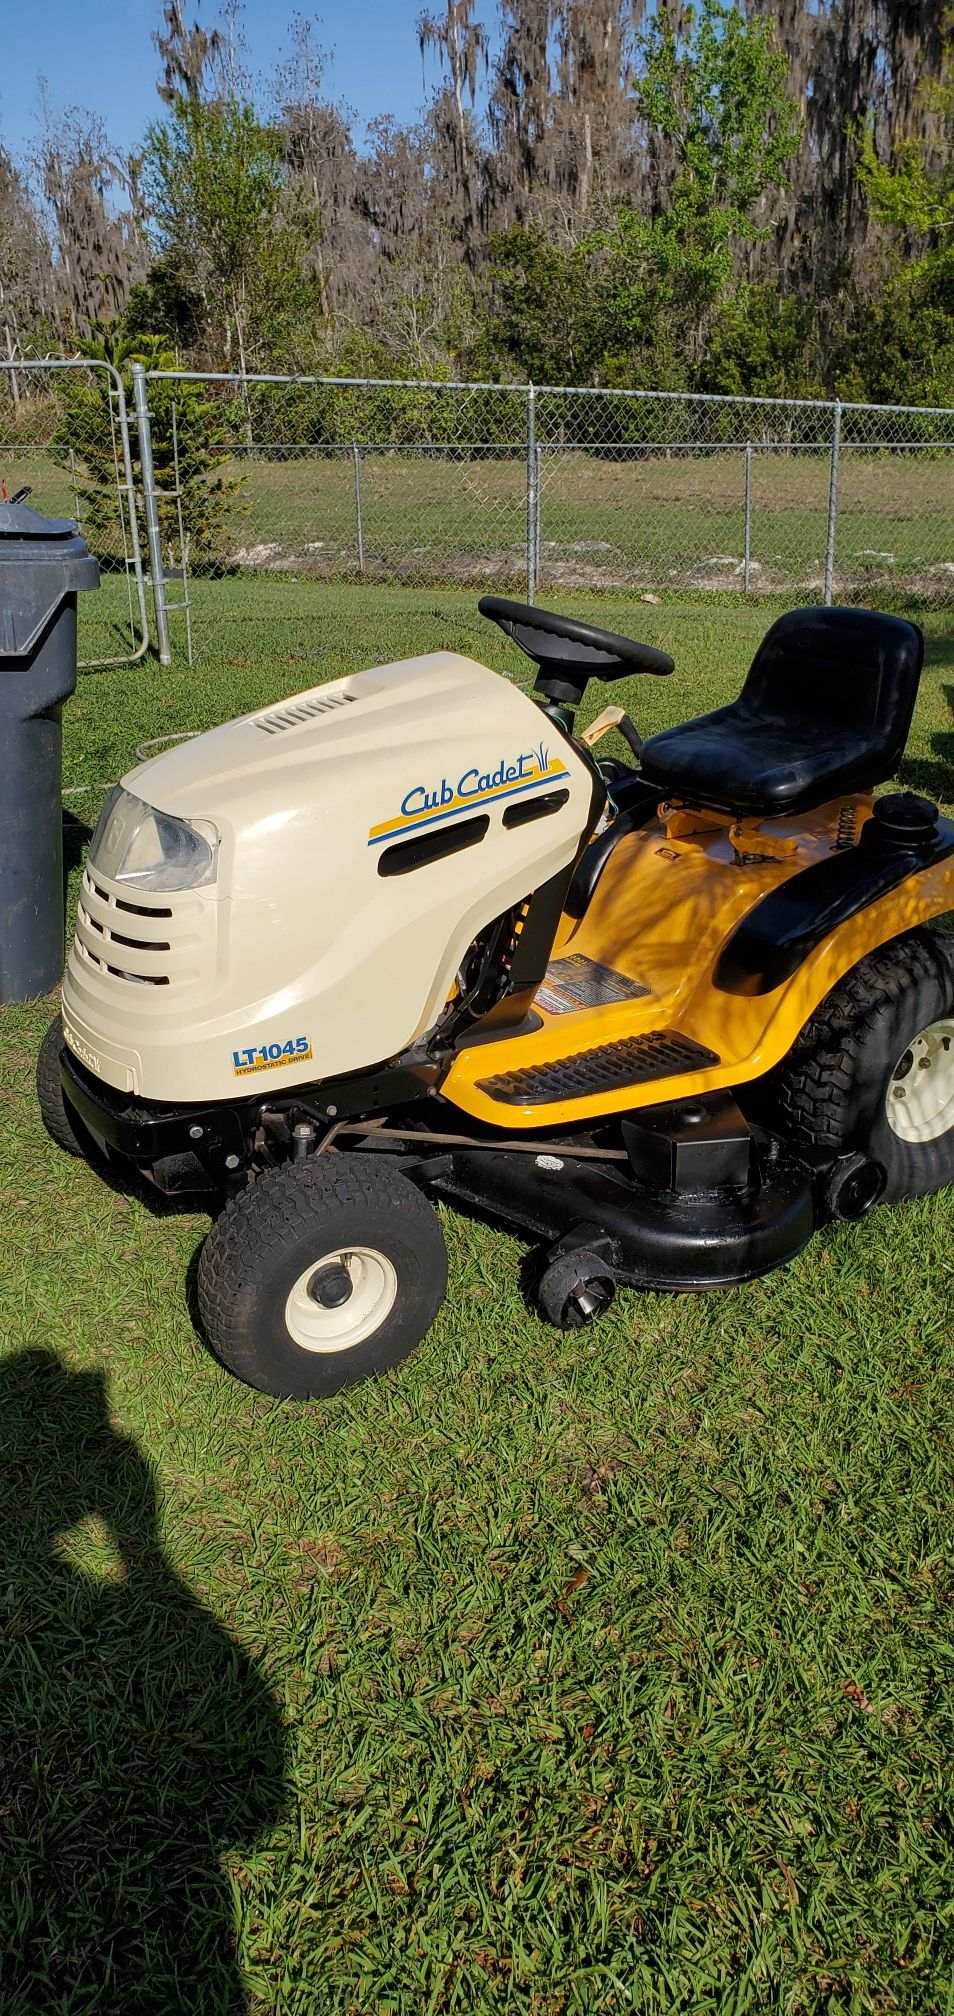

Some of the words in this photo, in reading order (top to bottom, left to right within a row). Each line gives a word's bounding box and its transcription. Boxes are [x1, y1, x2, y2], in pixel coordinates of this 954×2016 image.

[401, 779, 453, 816] Cub
[457, 754, 534, 798] Cadet
[232, 1036, 309, 1067] LT1045
[236, 1059, 287, 1075] HYDROSTATIC
[288, 1053, 310, 1064] DRIVE
